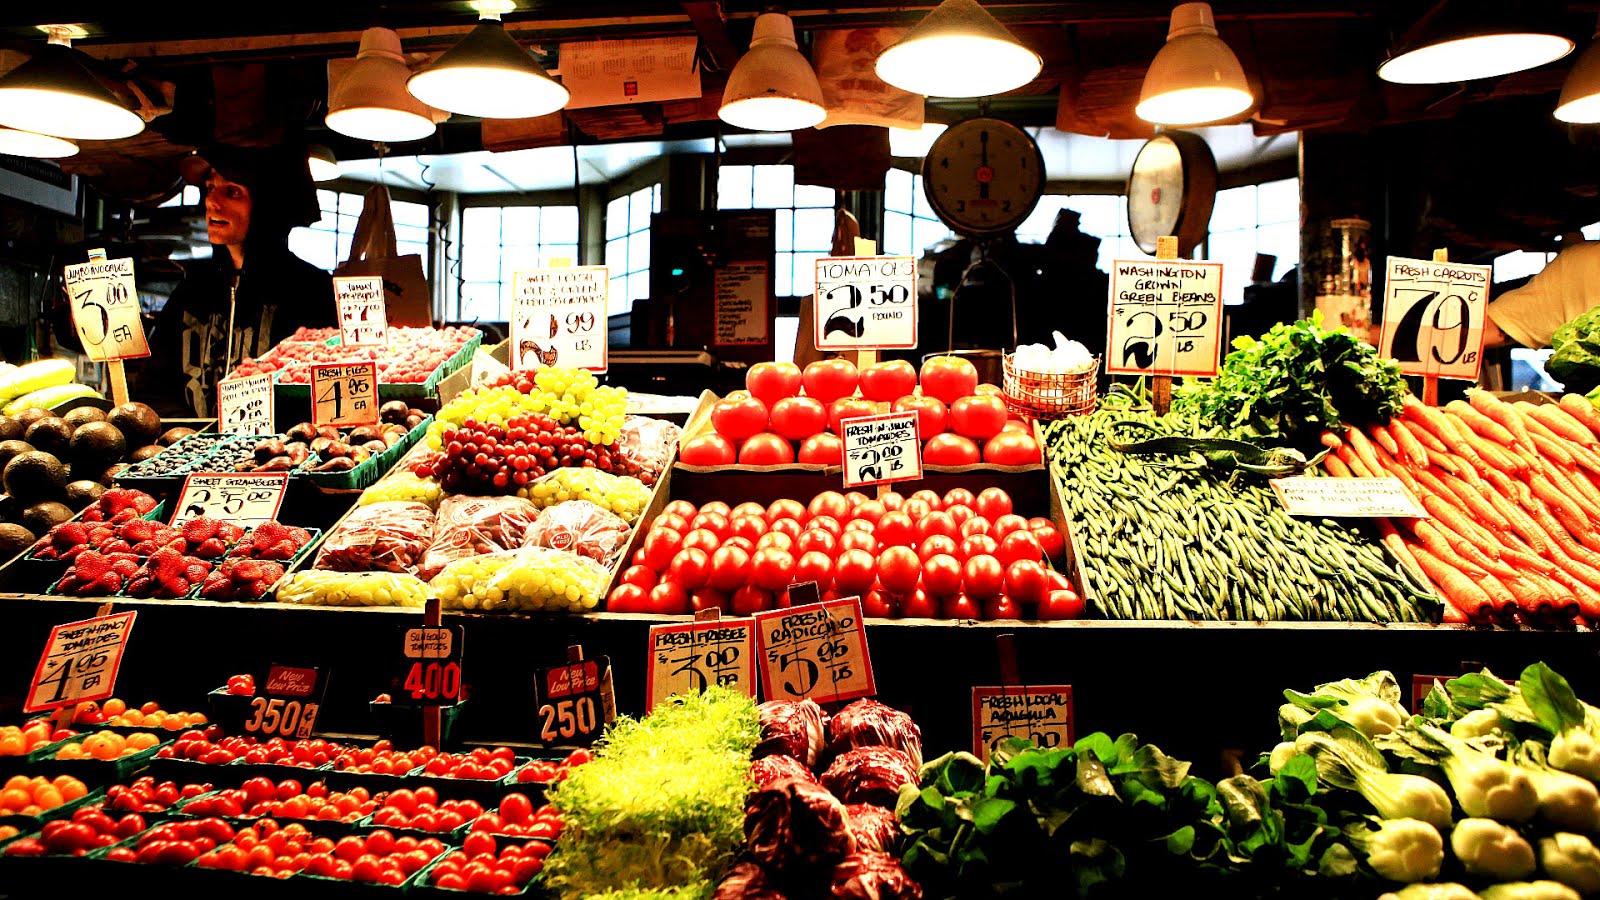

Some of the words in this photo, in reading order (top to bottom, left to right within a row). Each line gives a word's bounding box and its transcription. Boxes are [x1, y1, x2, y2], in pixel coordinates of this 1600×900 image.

[67, 266, 89, 280] JUMBO
[1119, 266, 1207, 280] WASHINGTON
[1394, 264, 1429, 277] FRESH
[1433, 267, 1486, 283] CARROTS
[1135, 279, 1182, 291] GROWN
[1120, 291, 1162, 303] GREEN
[1172, 291, 1216, 303] BEANS
[872, 311, 903, 321] POUND
[113, 325, 132, 343] EA
[1177, 340, 1194, 353] LB
[1462, 351, 1477, 364] LB
[318, 367, 342, 378] FRESH
[345, 365, 369, 376] FIGS
[354, 400, 367, 410] EA
[846, 424, 873, 438] FRESH
[888, 418, 915, 431] JUICY
[856, 430, 911, 446] TOMATOES
[890, 459, 904, 472] LB
[193, 478, 222, 487] SWEET
[782, 610, 828, 629] FRESH
[61, 632, 120, 651] TOMATOES
[656, 630, 695, 647] FRESH
[278, 670, 305, 681] New
[404, 661, 461, 699] 400
[560, 668, 584, 681] New
[832, 665, 853, 683] LB
[83, 675, 101, 691] EA
[266, 678, 287, 691] Low
[286, 680, 310, 693] Price
[551, 680, 570, 694] Low
[572, 677, 597, 690] Price
[981, 695, 1024, 709] FRESH
[1026, 693, 1067, 706] LOCAL
[539, 697, 596, 741] 250
